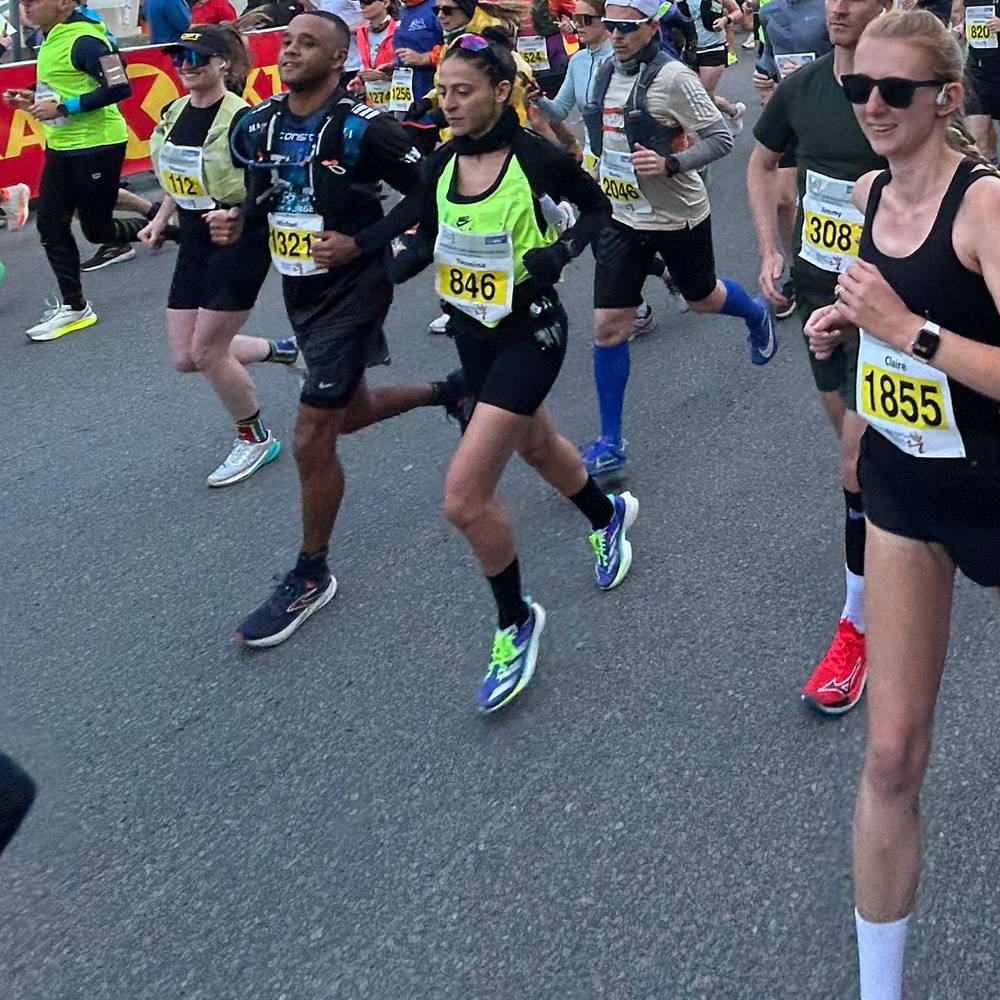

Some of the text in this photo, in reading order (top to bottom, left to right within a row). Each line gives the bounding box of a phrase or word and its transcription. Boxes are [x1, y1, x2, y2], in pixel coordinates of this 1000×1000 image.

[971, 25, 990, 38] 820
[392, 87, 412, 101] 1256
[168, 173, 198, 196] 112
[603, 177, 640, 200] 2046
[272, 231, 312, 257] 1321
[810, 216, 852, 251] 308
[449, 268, 496, 301] 846
[884, 355, 907, 372] Claire
[864, 369, 942, 427] 1855
